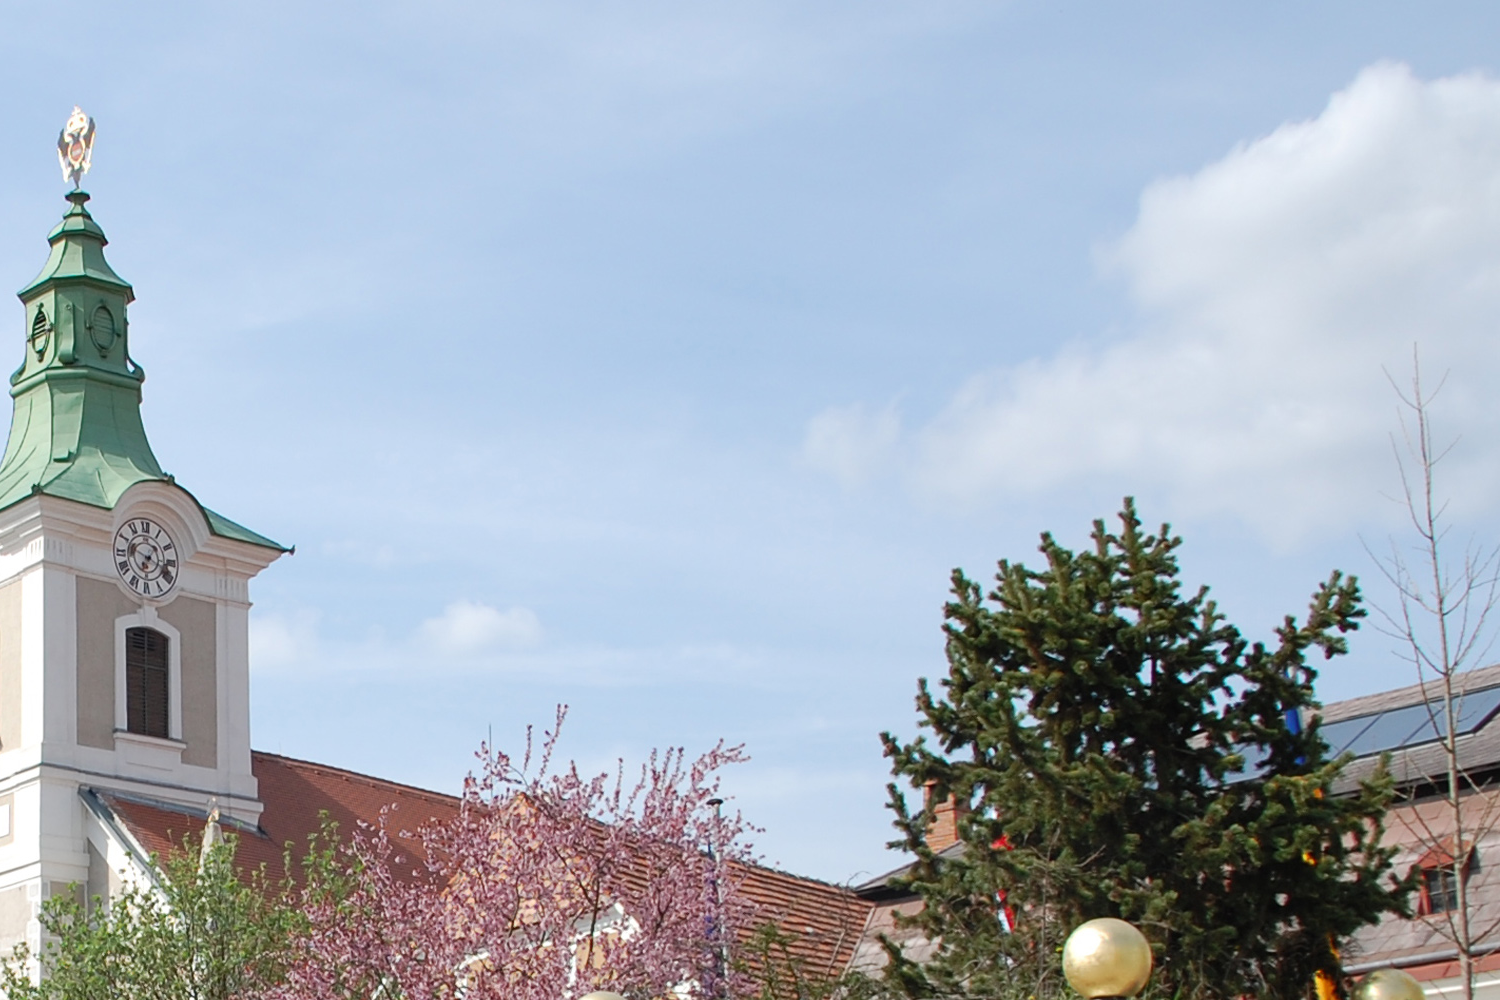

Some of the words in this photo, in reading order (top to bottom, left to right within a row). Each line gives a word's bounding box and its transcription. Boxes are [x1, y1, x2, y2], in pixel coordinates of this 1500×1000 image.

[141, 521, 150, 534] XII
[119, 532, 129, 543] X
[155, 530, 161, 539] I
